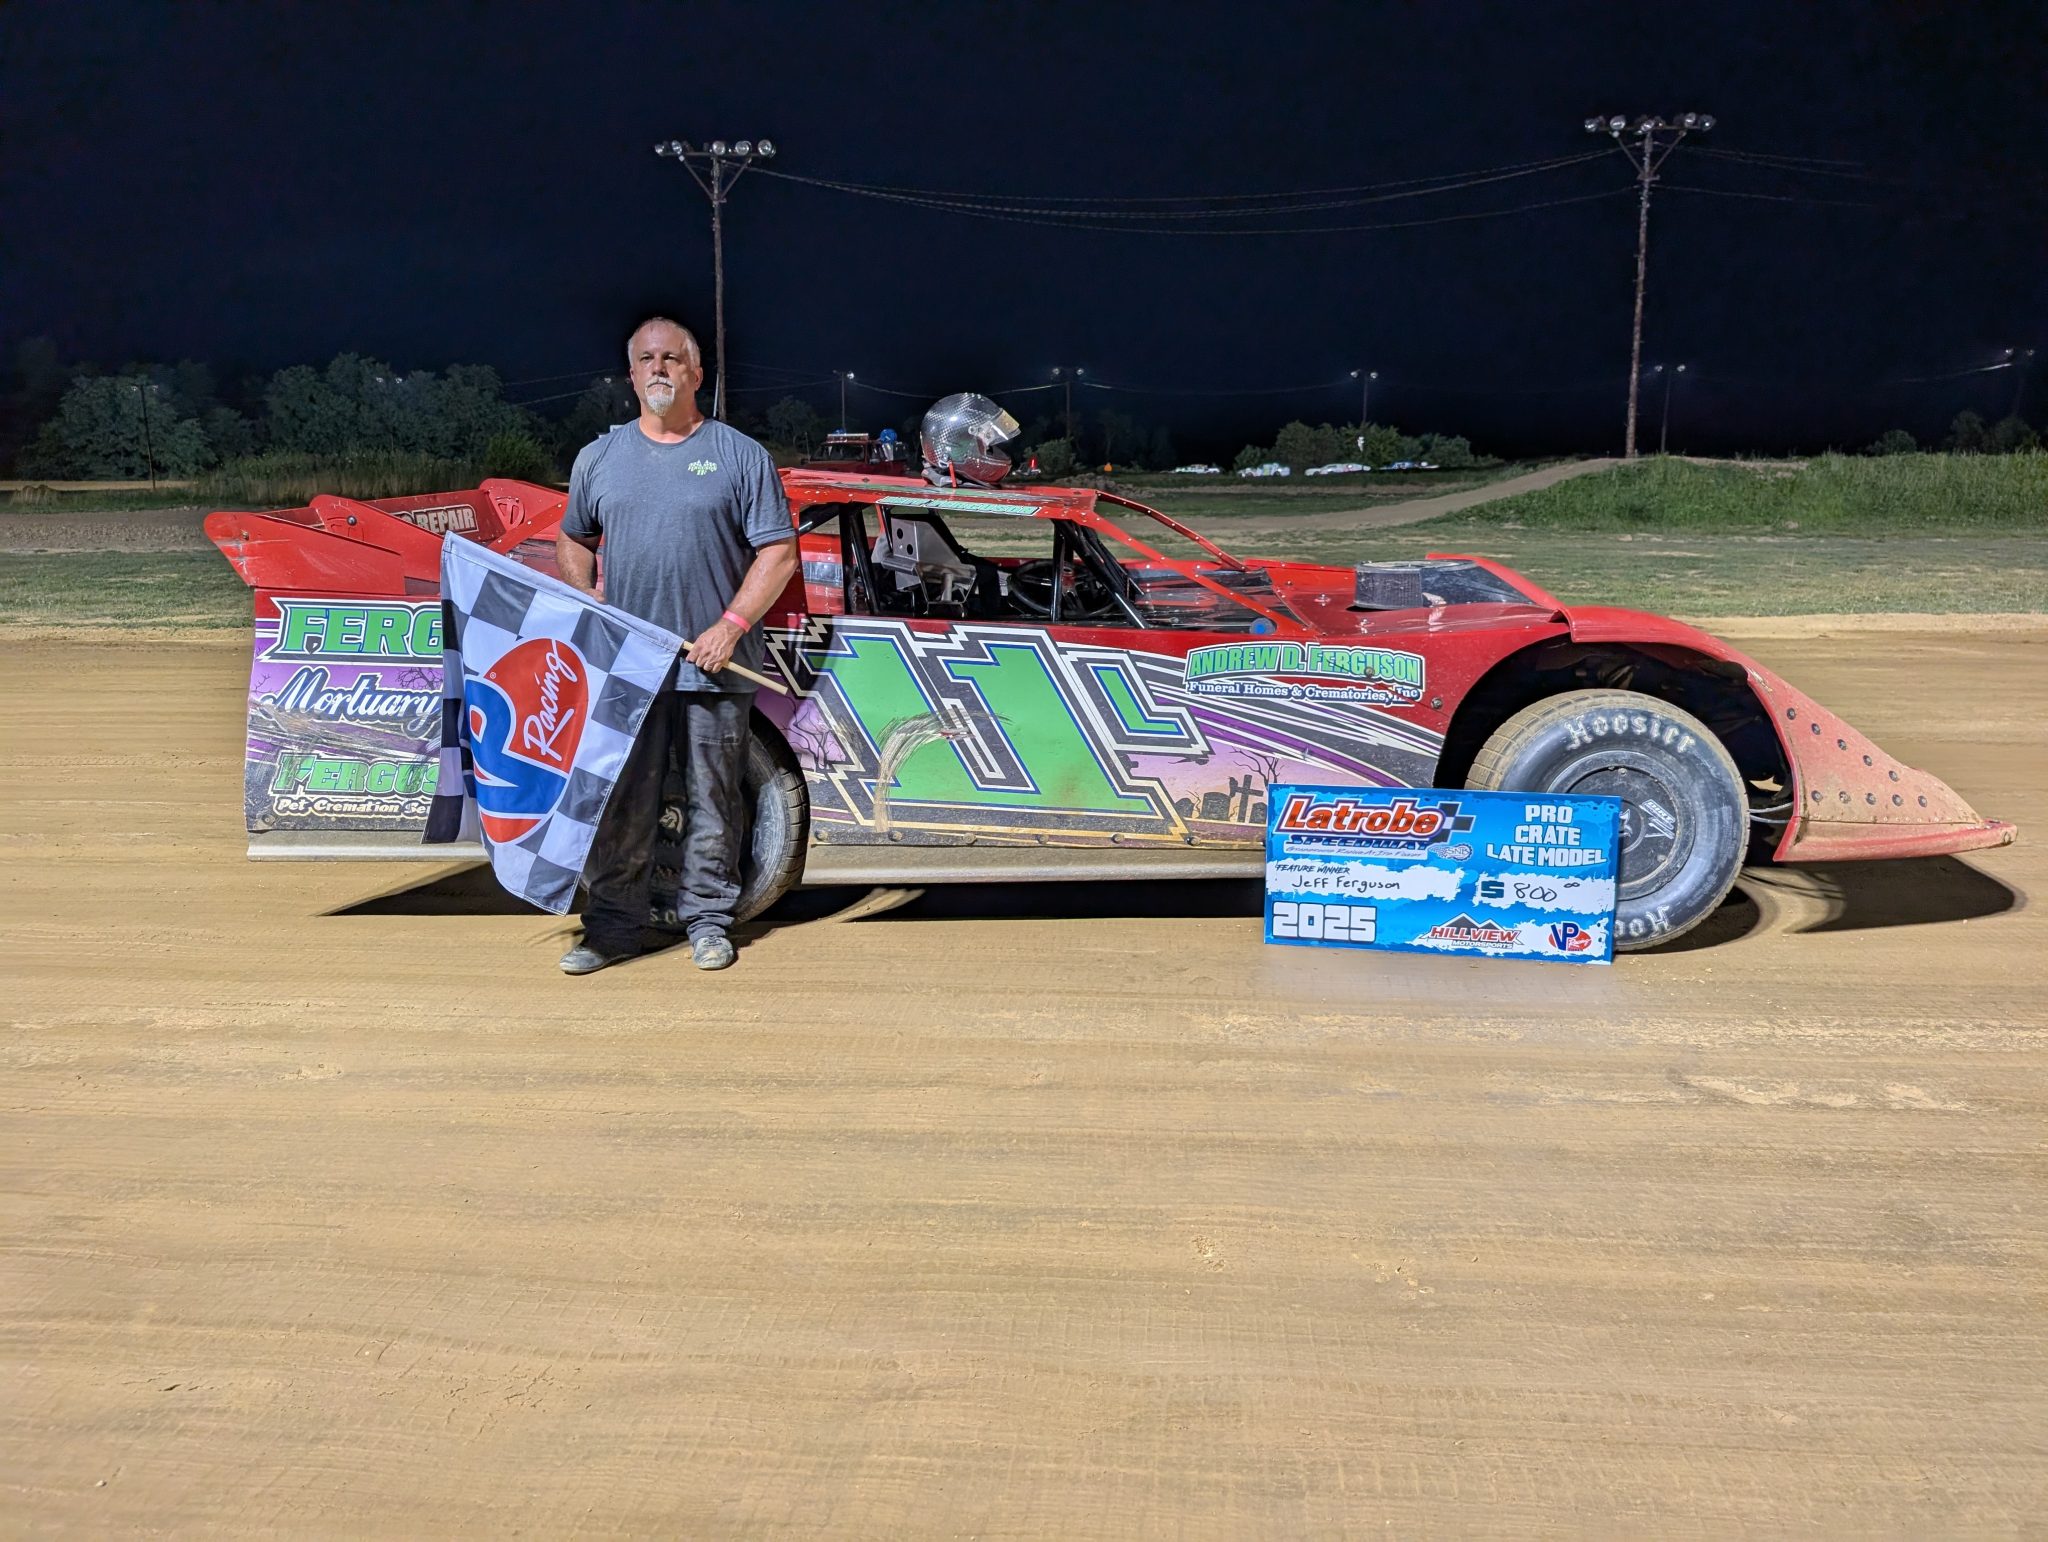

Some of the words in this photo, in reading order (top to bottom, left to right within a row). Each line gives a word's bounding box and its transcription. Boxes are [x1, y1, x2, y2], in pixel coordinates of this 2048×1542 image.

[415, 508, 475, 533] REPAIR
[1189, 646, 1280, 677] ANDREW
[1280, 647, 1305, 672] D.
[1308, 647, 1420, 684] FERGUSON
[523, 638, 578, 762] Racing
[1189, 682, 1241, 694] Funeral
[1243, 684, 1288, 696] Homes
[1291, 687, 1302, 697] &
[262, 670, 441, 731] Mortuary
[1563, 710, 1697, 753] Hoosier
[278, 798, 304, 811] Pet
[314, 800, 400, 814] Cremation
[1525, 804, 1573, 823] PRO
[1284, 800, 1440, 834] Latrobe
[1287, 834, 1432, 850] SPEEDWAY
[1514, 825, 1581, 846] CRATE
[1486, 843, 1537, 865] LATE
[1538, 848, 1608, 867] MODEL
[1275, 864, 1315, 873] FEATURE
[1317, 865, 1351, 875] WINNER
[1336, 875, 1400, 893] Ferguson
[1513, 882, 1558, 902] 800
[1273, 902, 1377, 941] 2025
[1430, 927, 1519, 942] HILLVIEW
[1452, 940, 1514, 949] MOTORSPORTS
[1551, 922, 1579, 951] VP
